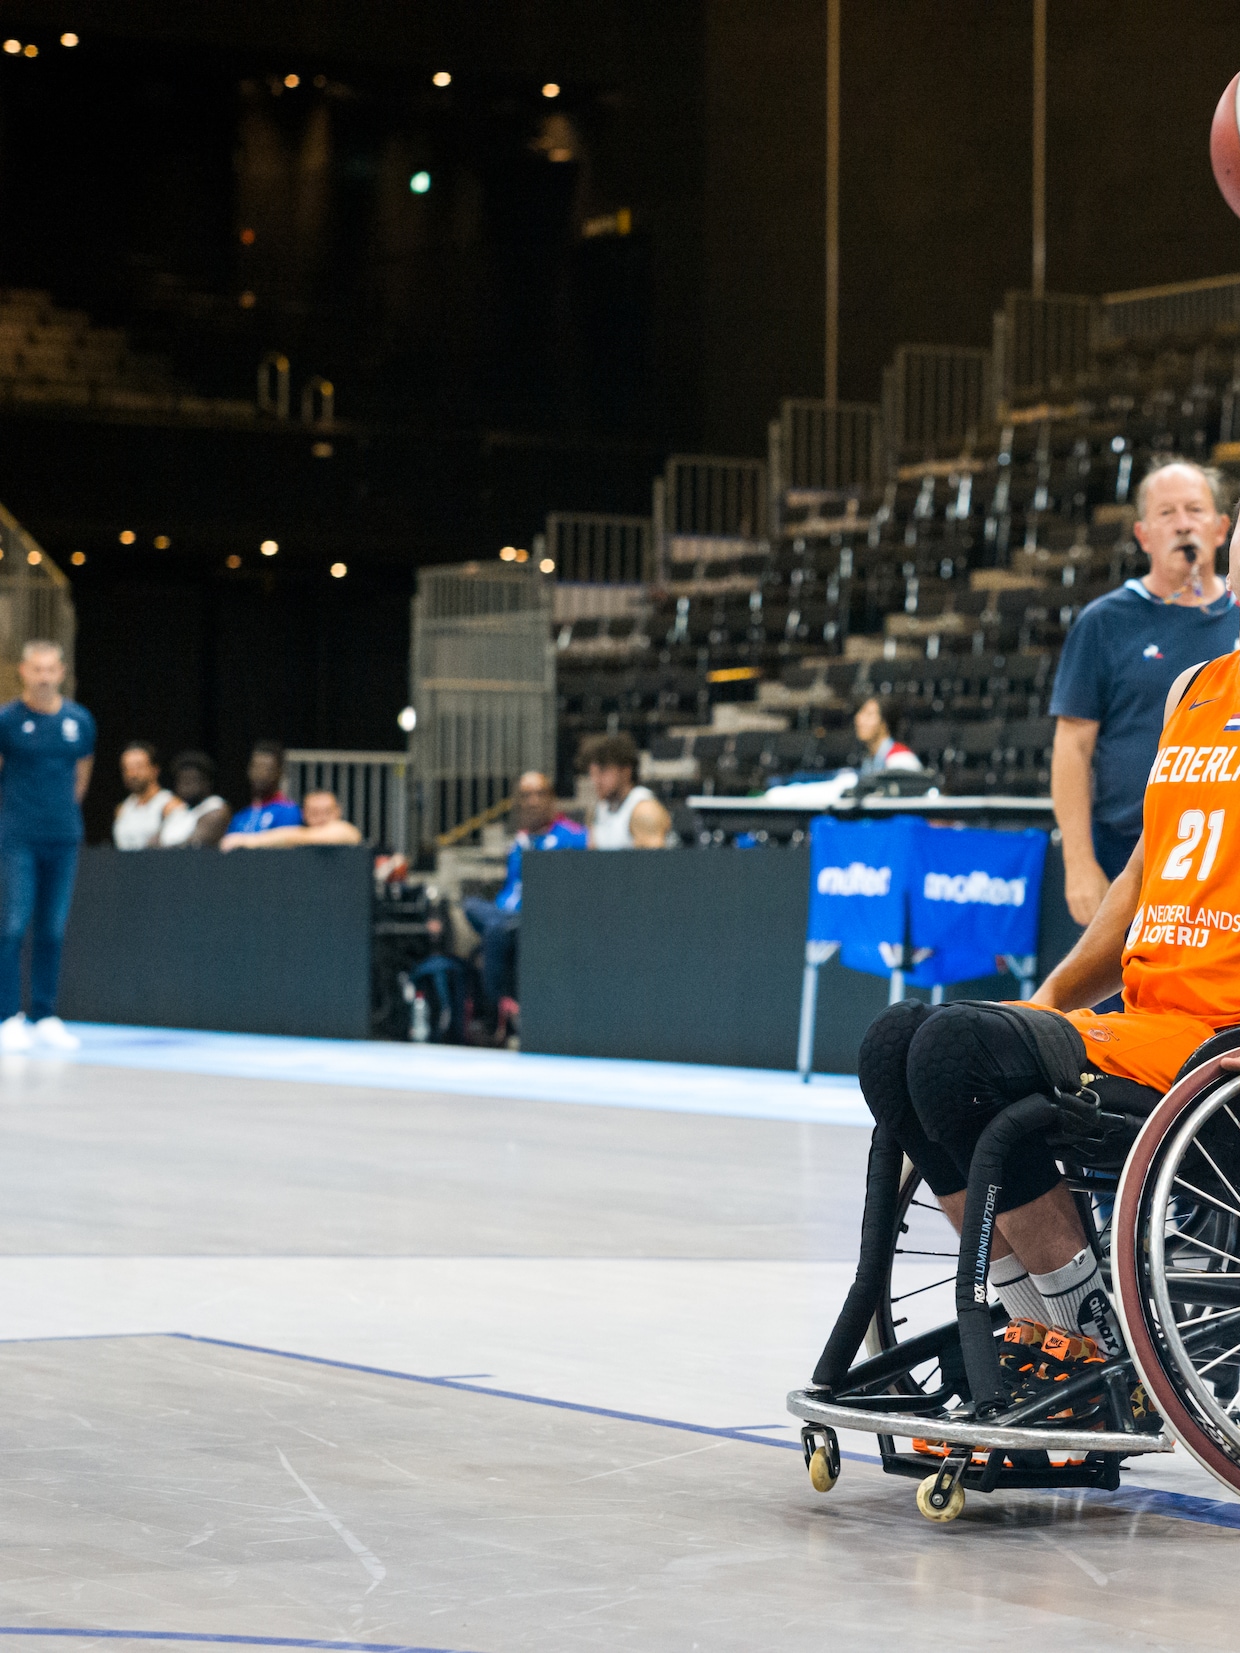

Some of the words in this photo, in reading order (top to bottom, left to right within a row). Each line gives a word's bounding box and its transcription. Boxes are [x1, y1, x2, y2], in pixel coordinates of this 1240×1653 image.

[1161, 809, 1226, 881] 21
[1141, 924, 1210, 949] LOTERIJ
[1049, 1335, 1065, 1348] NIKE
[1088, 1296, 1121, 1351] airmax
